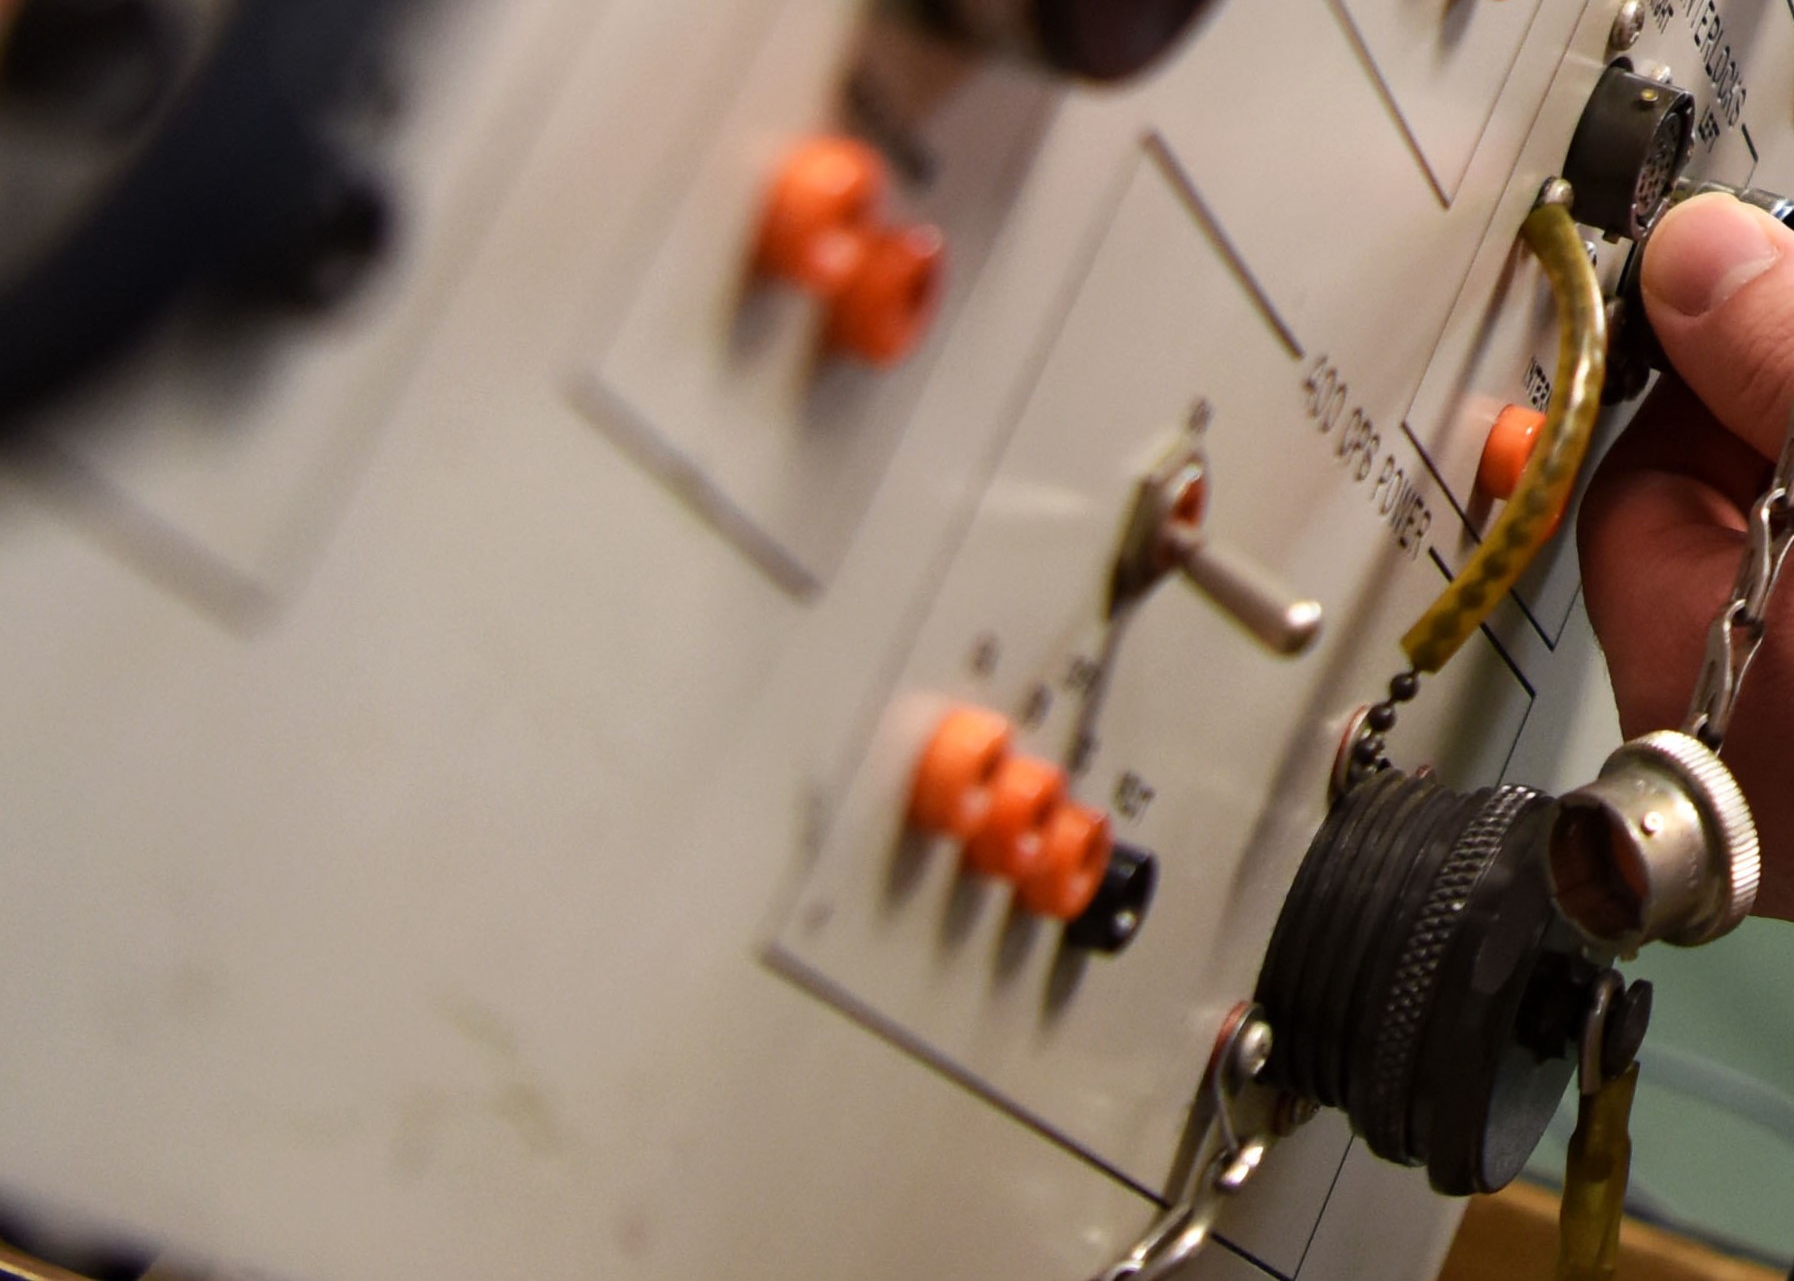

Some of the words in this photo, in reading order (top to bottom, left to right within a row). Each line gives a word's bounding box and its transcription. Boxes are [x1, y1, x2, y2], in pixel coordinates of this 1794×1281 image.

[1698, 105, 1721, 153] LEFT
[1302, 355, 1348, 434] 400
[1334, 406, 1381, 482] CPS
[1370, 453, 1432, 563] POWER
